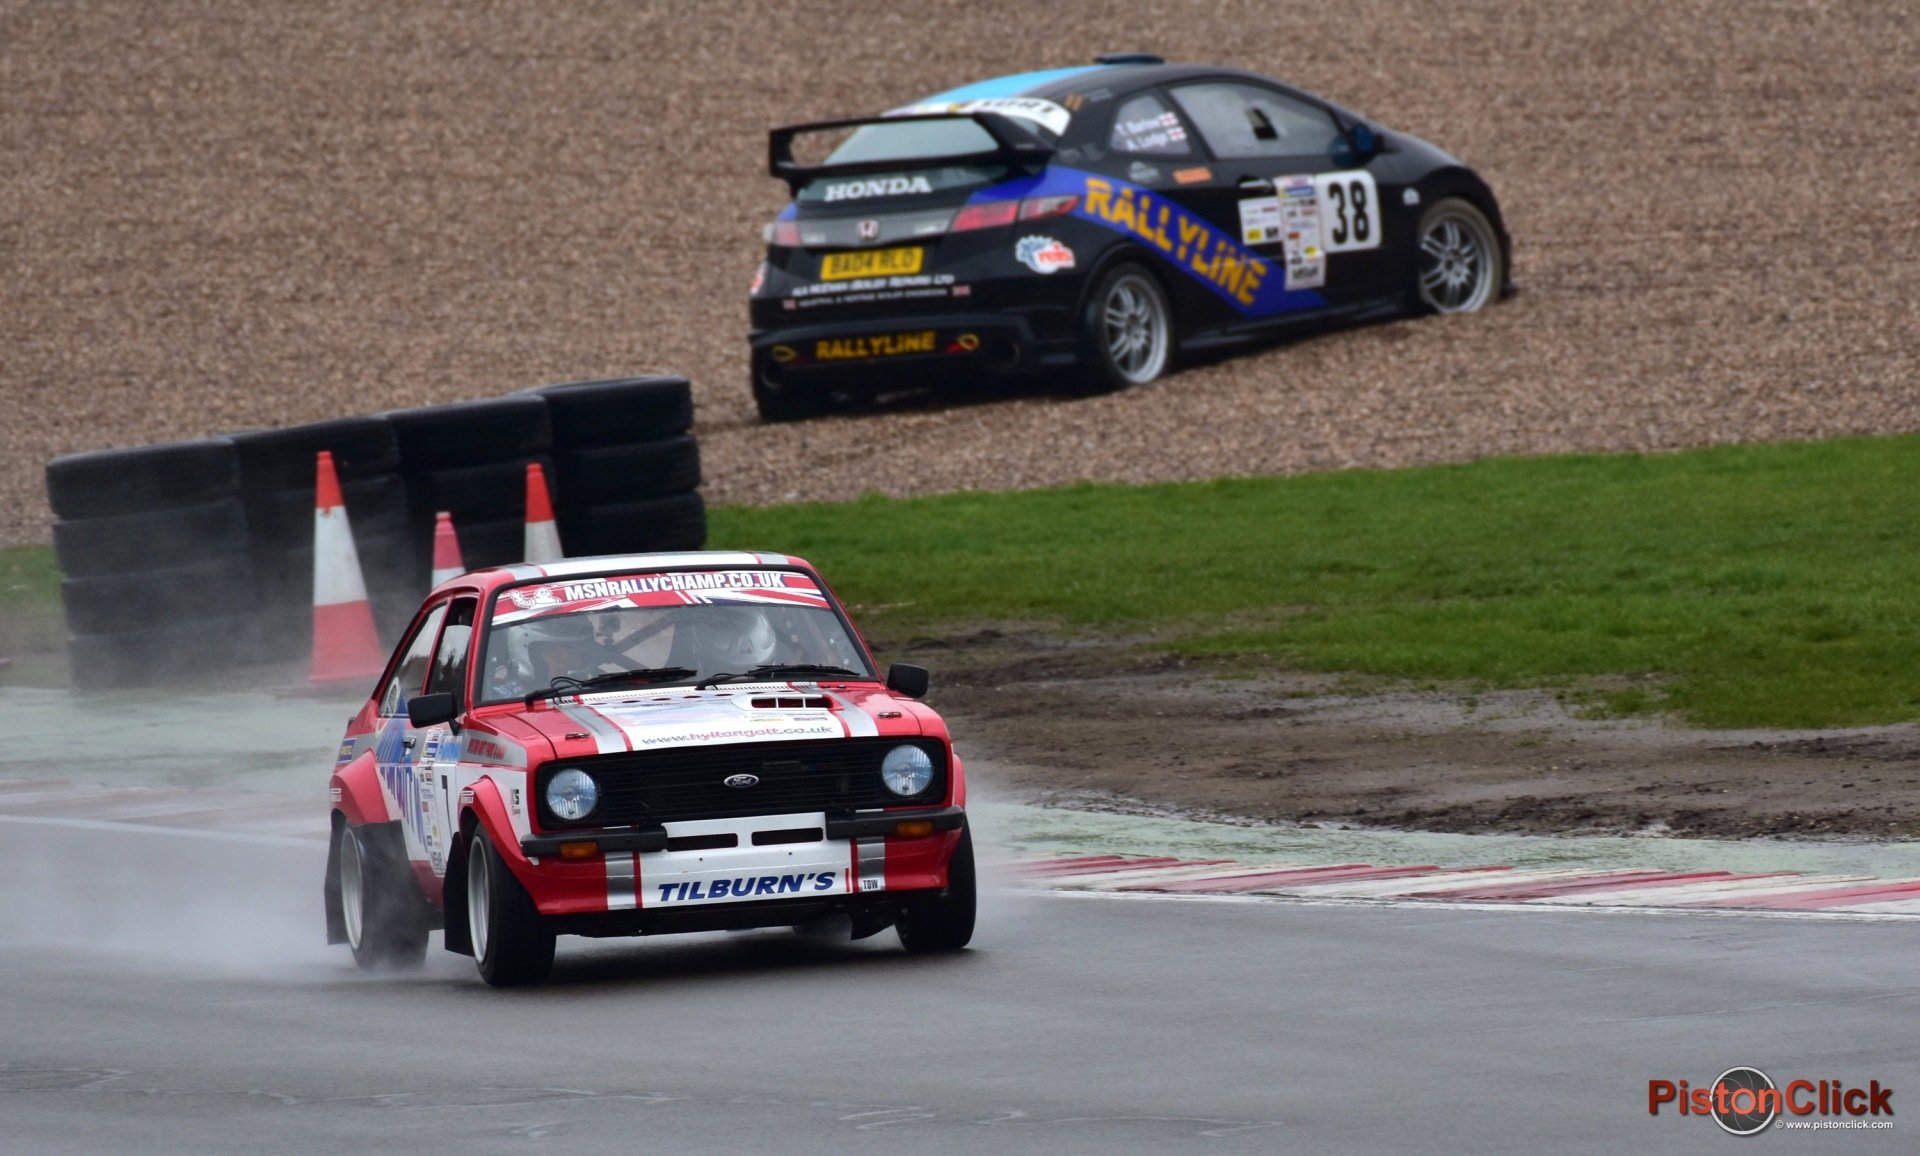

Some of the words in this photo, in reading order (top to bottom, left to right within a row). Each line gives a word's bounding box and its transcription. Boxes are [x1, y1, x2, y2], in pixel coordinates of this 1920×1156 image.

[824, 176, 932, 201] HONDA
[1328, 181, 1370, 245] 38
[1084, 177, 1268, 307] RALLYLINE
[816, 331, 937, 360] RALLYLINE
[565, 573, 786, 601] MSNRALLYCHAMP.CO.UK
[658, 871, 836, 902] TILBURN'S
[863, 879, 878, 890] TOW
